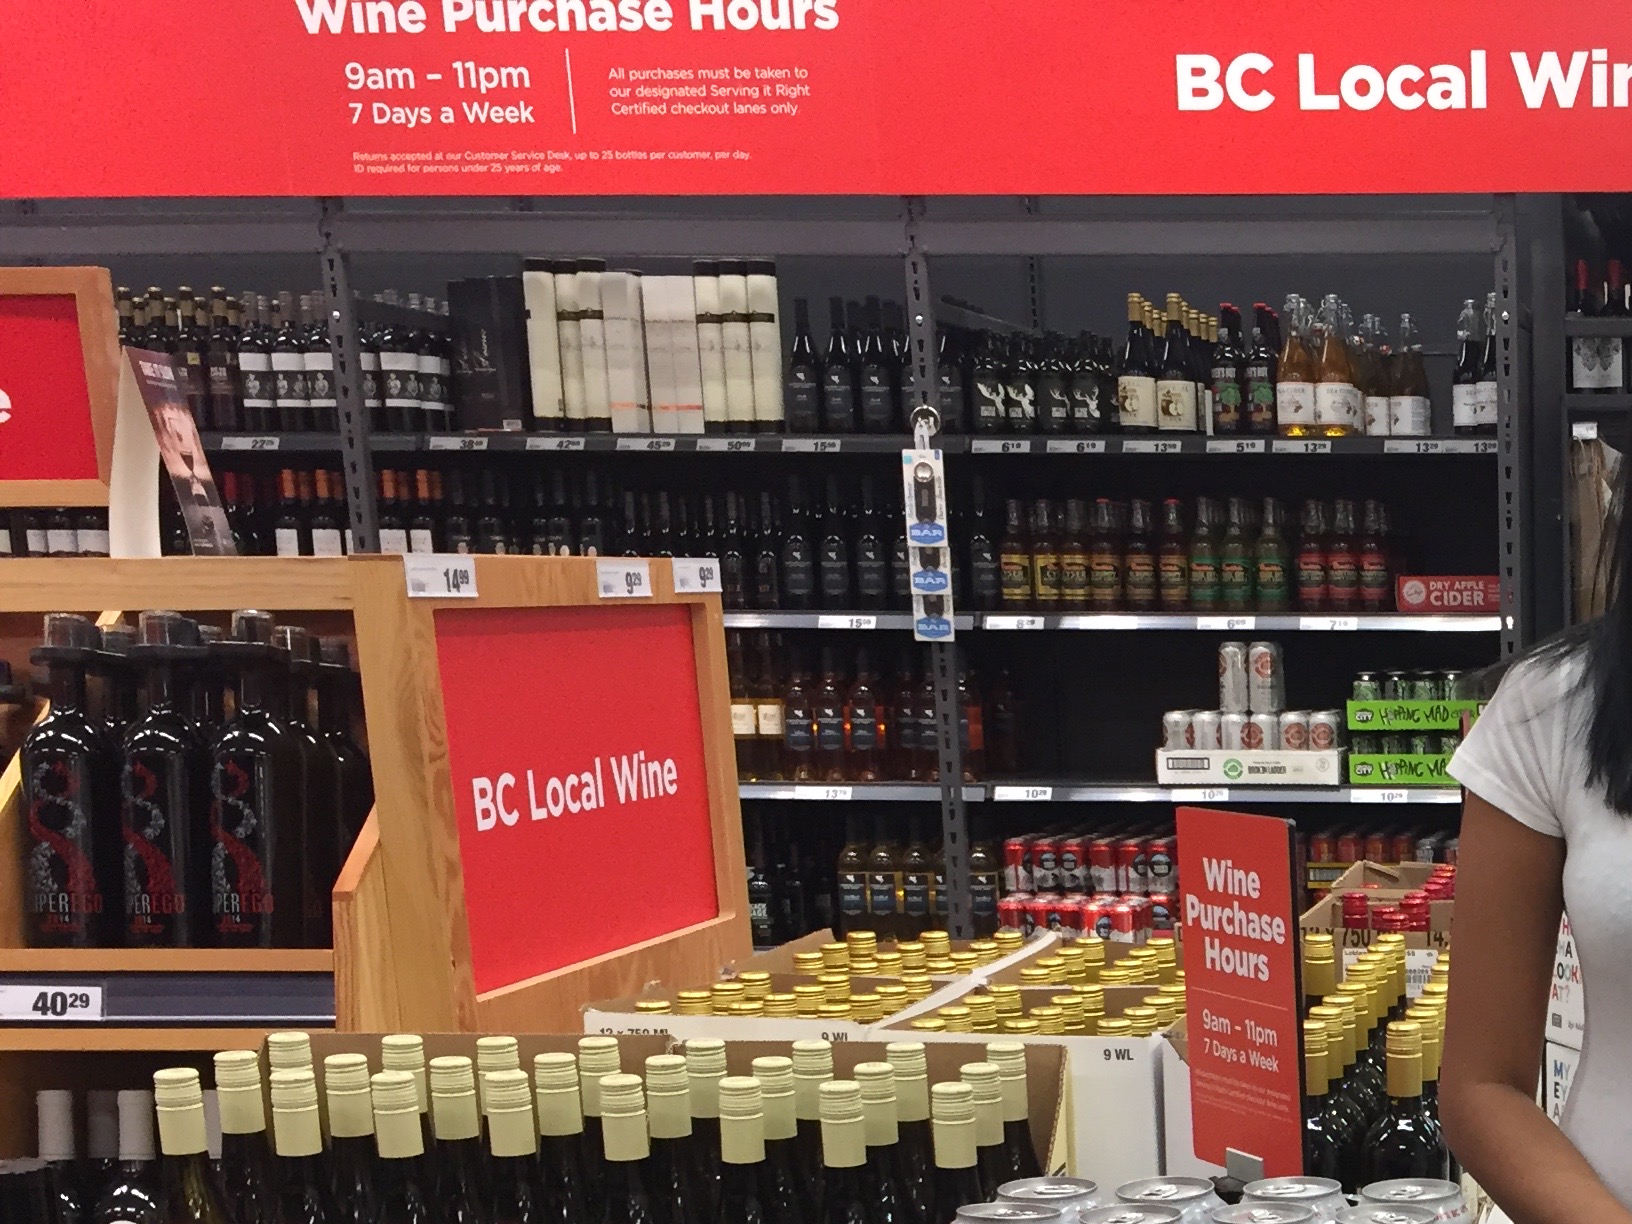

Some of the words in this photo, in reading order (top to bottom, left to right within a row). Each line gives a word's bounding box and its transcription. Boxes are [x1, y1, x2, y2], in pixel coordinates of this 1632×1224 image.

[295, 0, 426, 34] Wine
[442, 0, 673, 32] Purchase
[688, 0, 839, 31] Hours
[345, 62, 415, 90] 9am
[452, 61, 530, 94] 11pm
[608, 68, 624, 79] All
[629, 68, 694, 83] purchases
[698, 68, 729, 79] must
[734, 67, 750, 79] be
[755, 67, 790, 79] taken
[794, 67, 808, 79] to
[609, 87, 630, 97] our
[636, 84, 706, 99] designated
[710, 85, 759, 99] Serving
[763, 84, 771, 96] it
[776, 84, 810, 99] Right
[1176, 53, 1275, 112] BC
[1299, 49, 1487, 111] Local
[349, 103, 363, 124] 7
[372, 102, 431, 128] Days
[440, 106, 454, 123] a
[462, 101, 535, 123] Week
[611, 102, 666, 115] Certified
[671, 102, 729, 114] checkout
[734, 102, 766, 114] lanes
[771, 102, 798, 116] only
[1430, 581, 1449, 590] DRY
[1430, 591, 1485, 606] CIDER
[472, 773, 520, 832] BC
[527, 757, 603, 821] Local
[610, 750, 679, 803] Wine
[1202, 857, 1260, 899] Wine
[1186, 893, 1286, 944] Purchase
[1204, 936, 1269, 981] Hours
[1203, 1009, 1231, 1035] 9am
[1245, 1019, 1277, 1047] 11pm
[1104, 1049, 1111, 1061] 9
[1115, 1049, 1134, 1061] WL
[1204, 1038, 1210, 1053] 7
[1213, 1040, 1237, 1062] Days
[1240, 1051, 1246, 1063] a
[1248, 1049, 1279, 1073] Week
